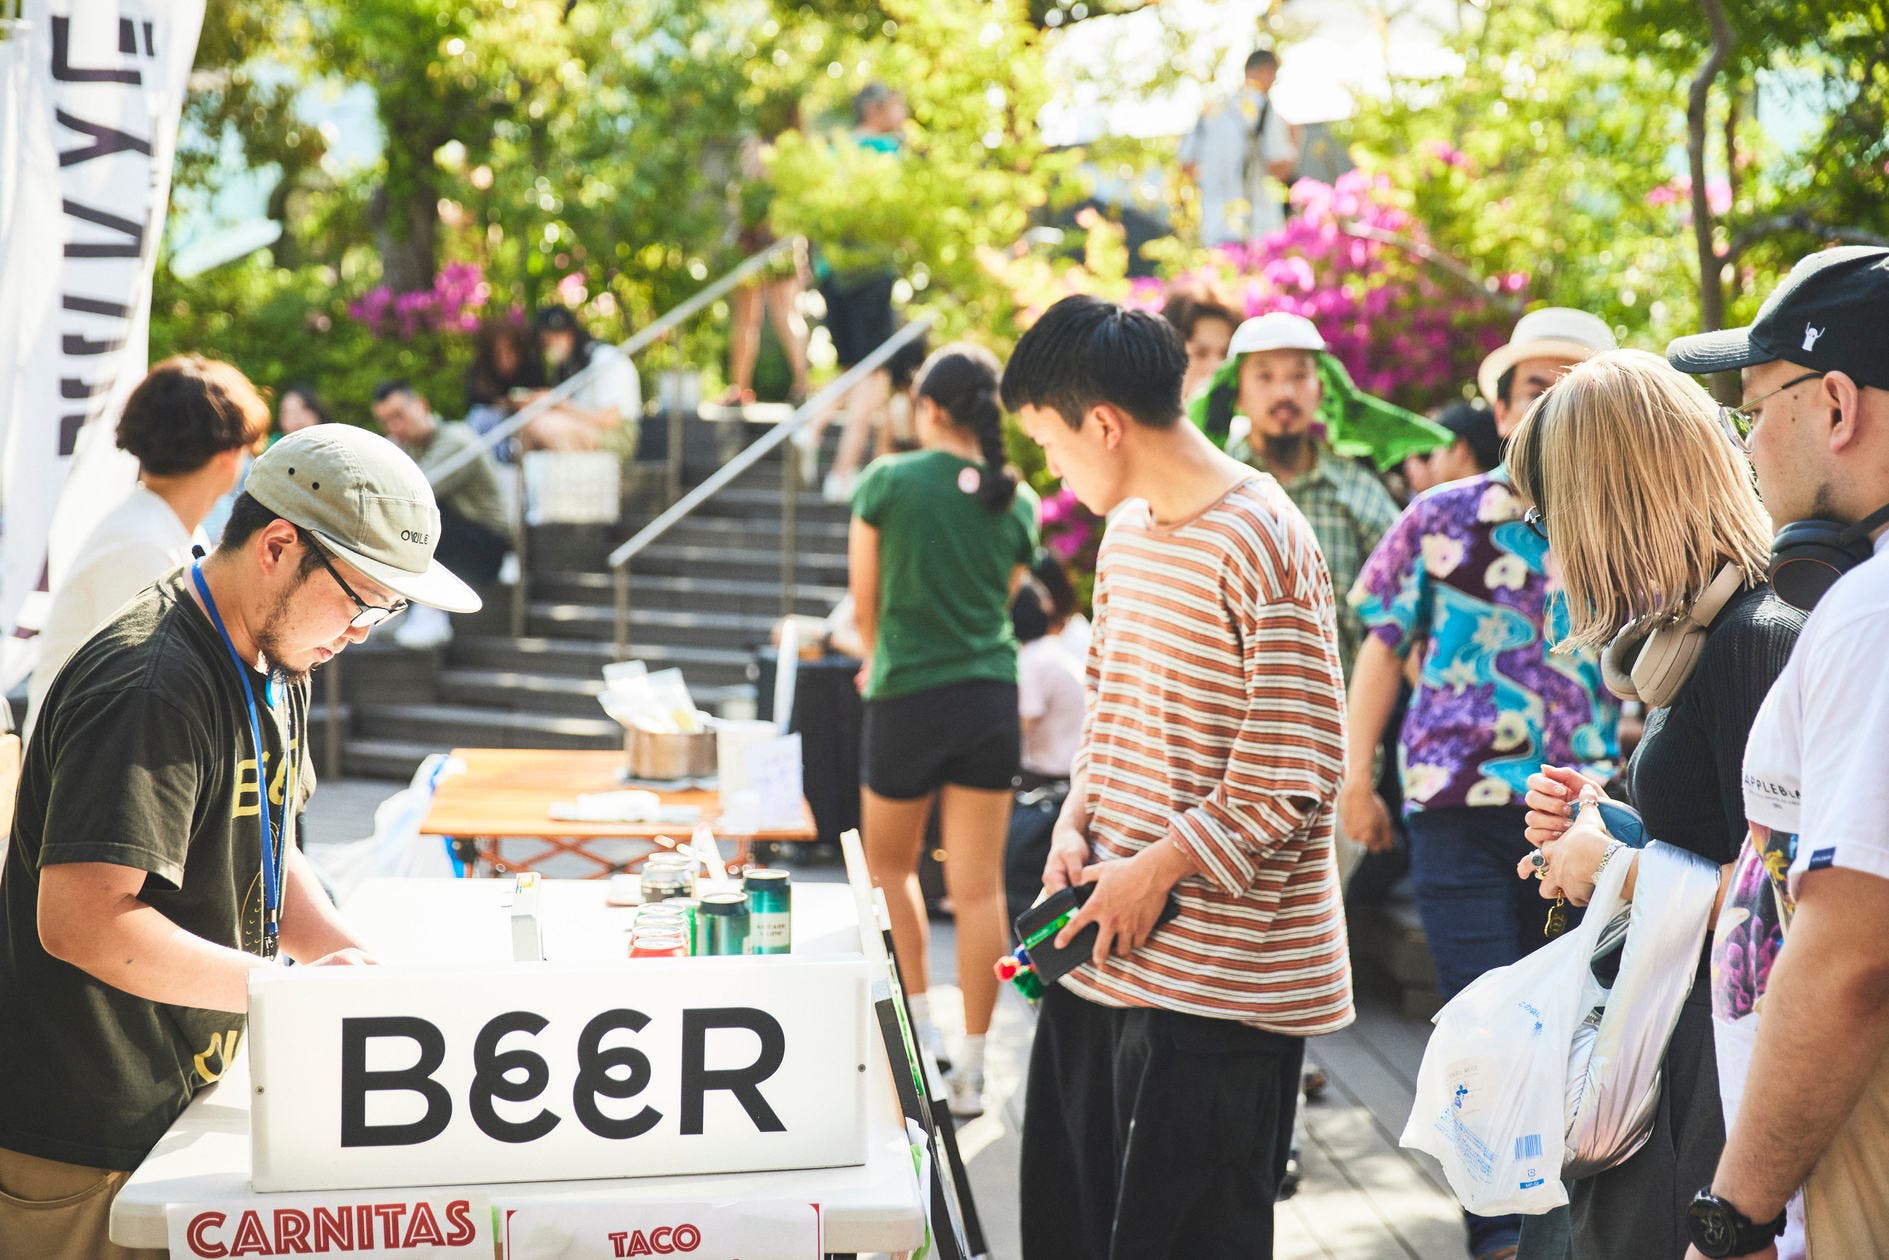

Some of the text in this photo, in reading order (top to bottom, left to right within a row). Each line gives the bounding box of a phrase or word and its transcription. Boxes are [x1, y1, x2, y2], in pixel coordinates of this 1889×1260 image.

[341, 1007, 788, 1148] BEER
[186, 1200, 476, 1259] CARNITAS
[608, 1223, 701, 1258] TACO
